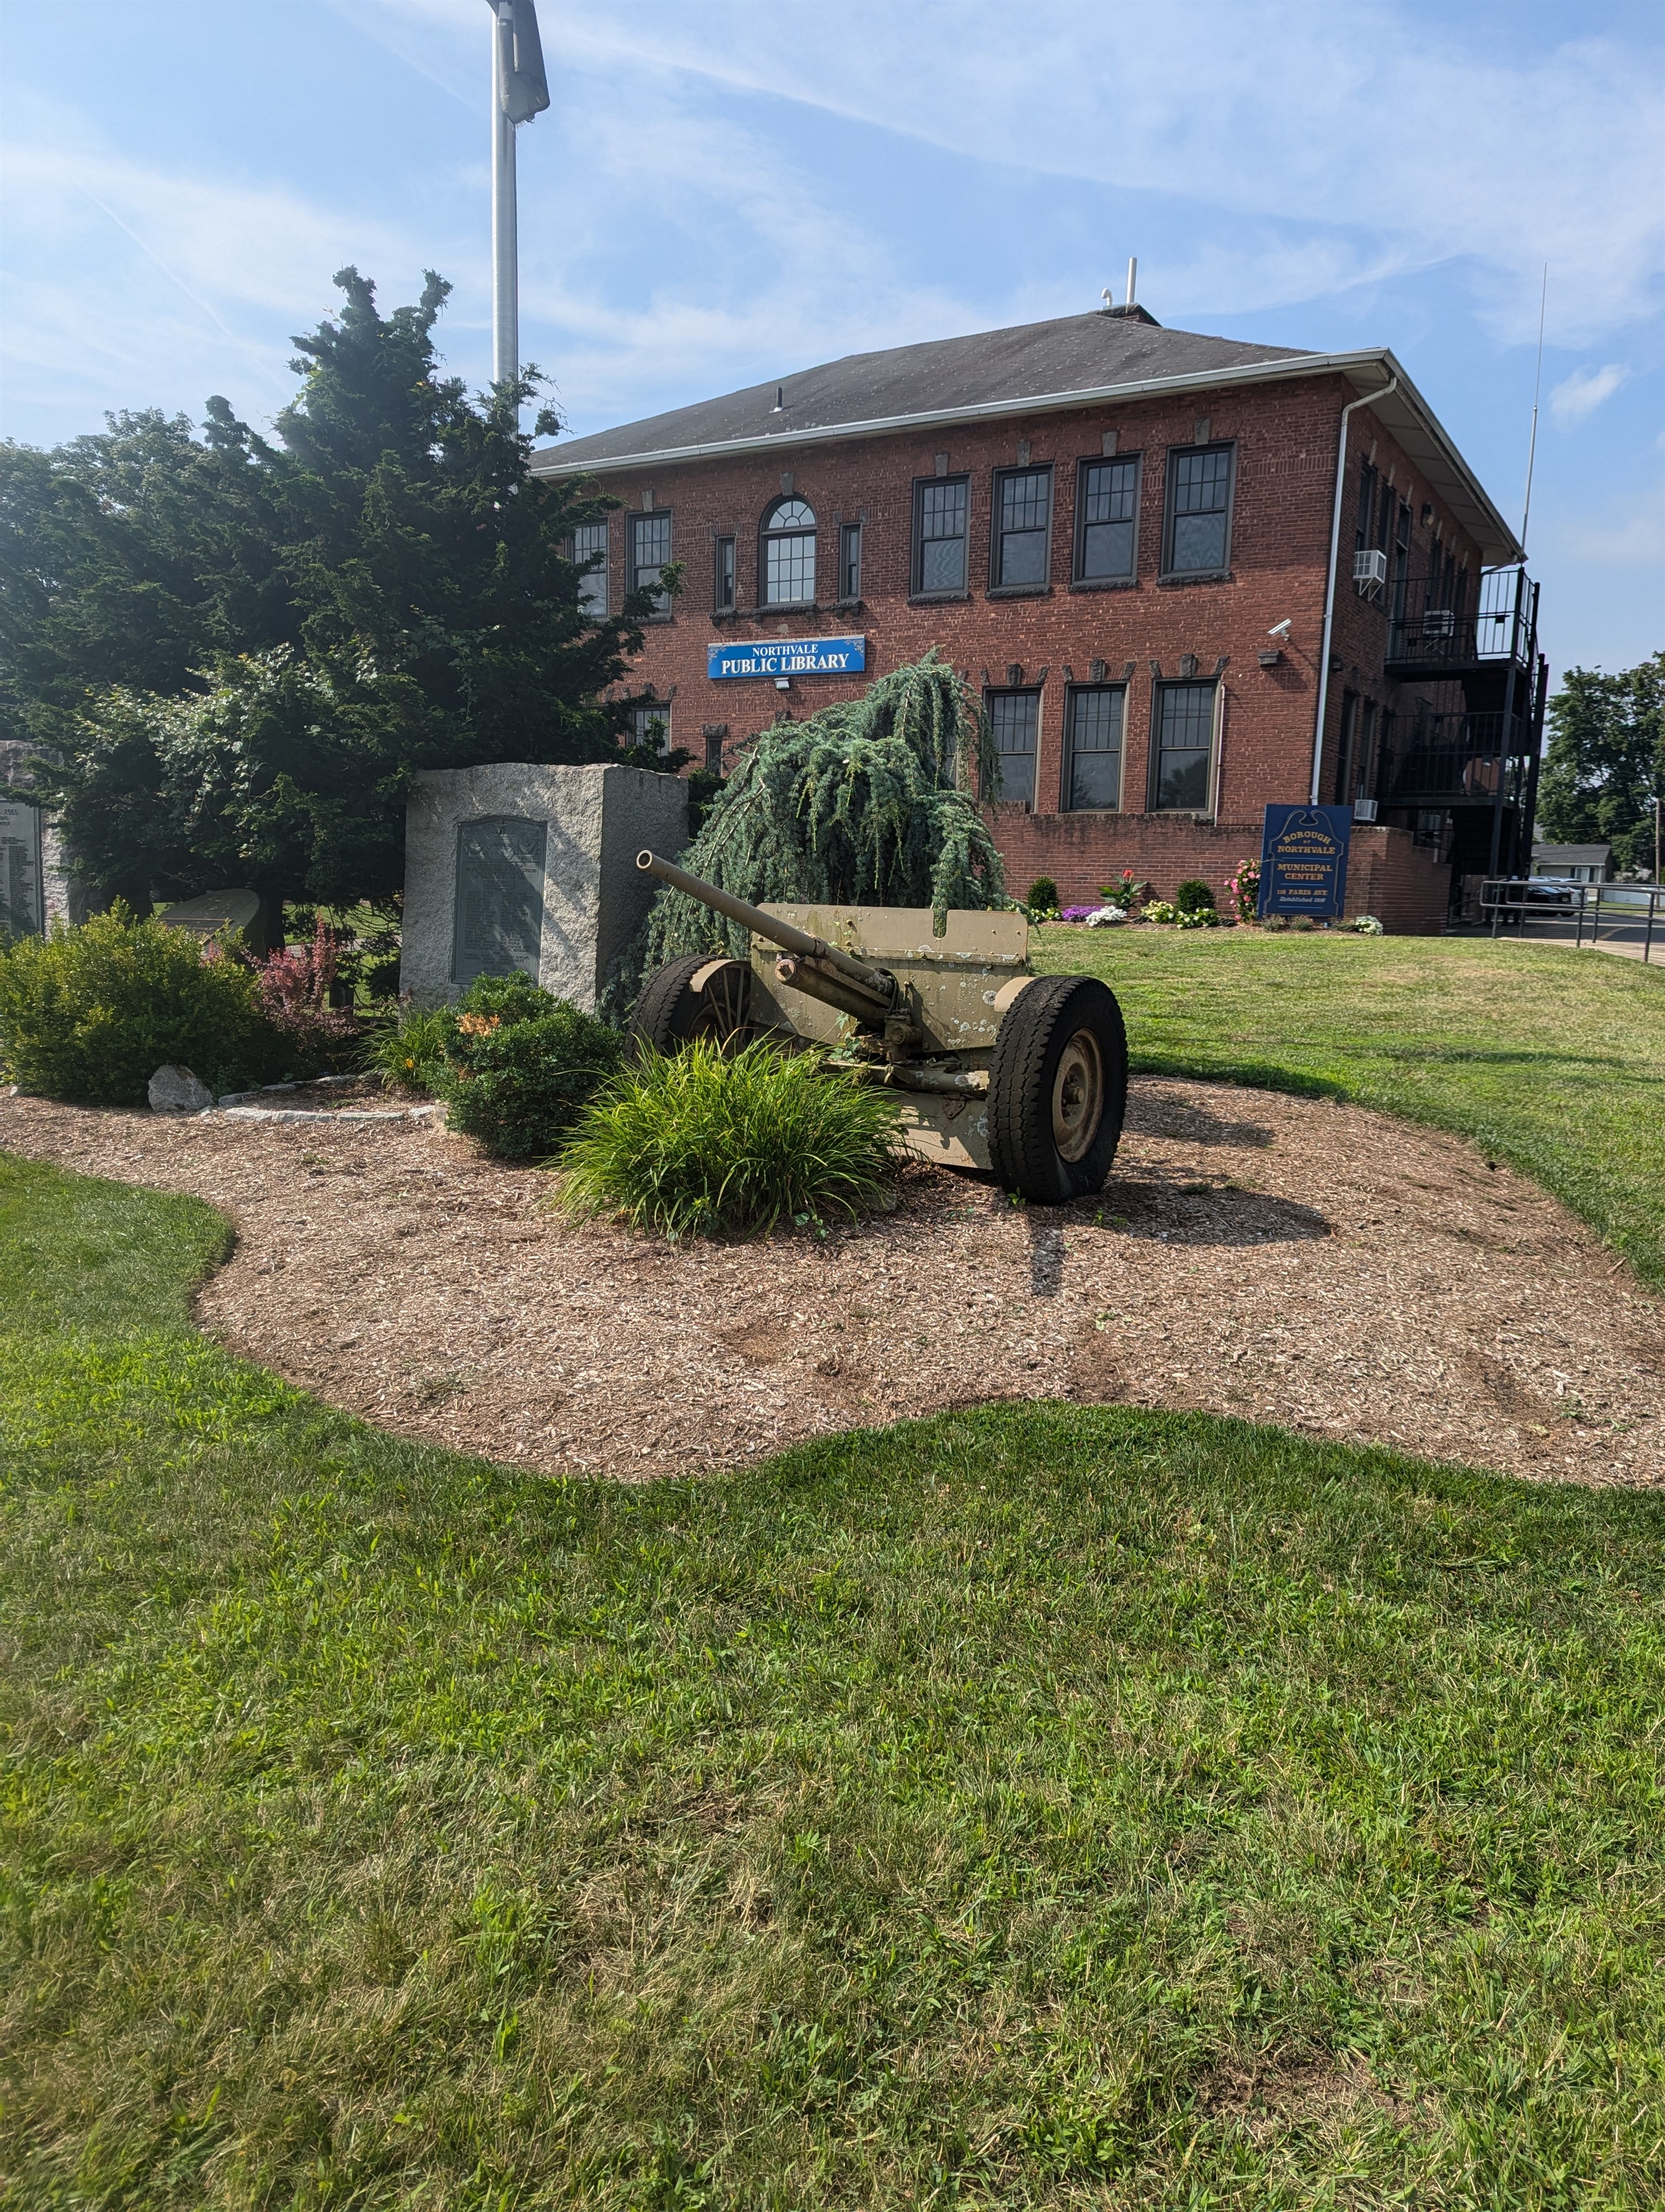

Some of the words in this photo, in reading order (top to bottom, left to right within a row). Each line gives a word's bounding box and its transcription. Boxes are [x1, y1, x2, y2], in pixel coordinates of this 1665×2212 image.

[752, 643, 818, 657] NORTHVALE
[721, 657, 777, 675] PUBLIC
[780, 653, 849, 672] LIBRARY
[1283, 831, 1332, 844] BOROUGH
[1277, 846, 1336, 854] NORTHVALE
[1277, 863, 1333, 872] MUNICIPAL
